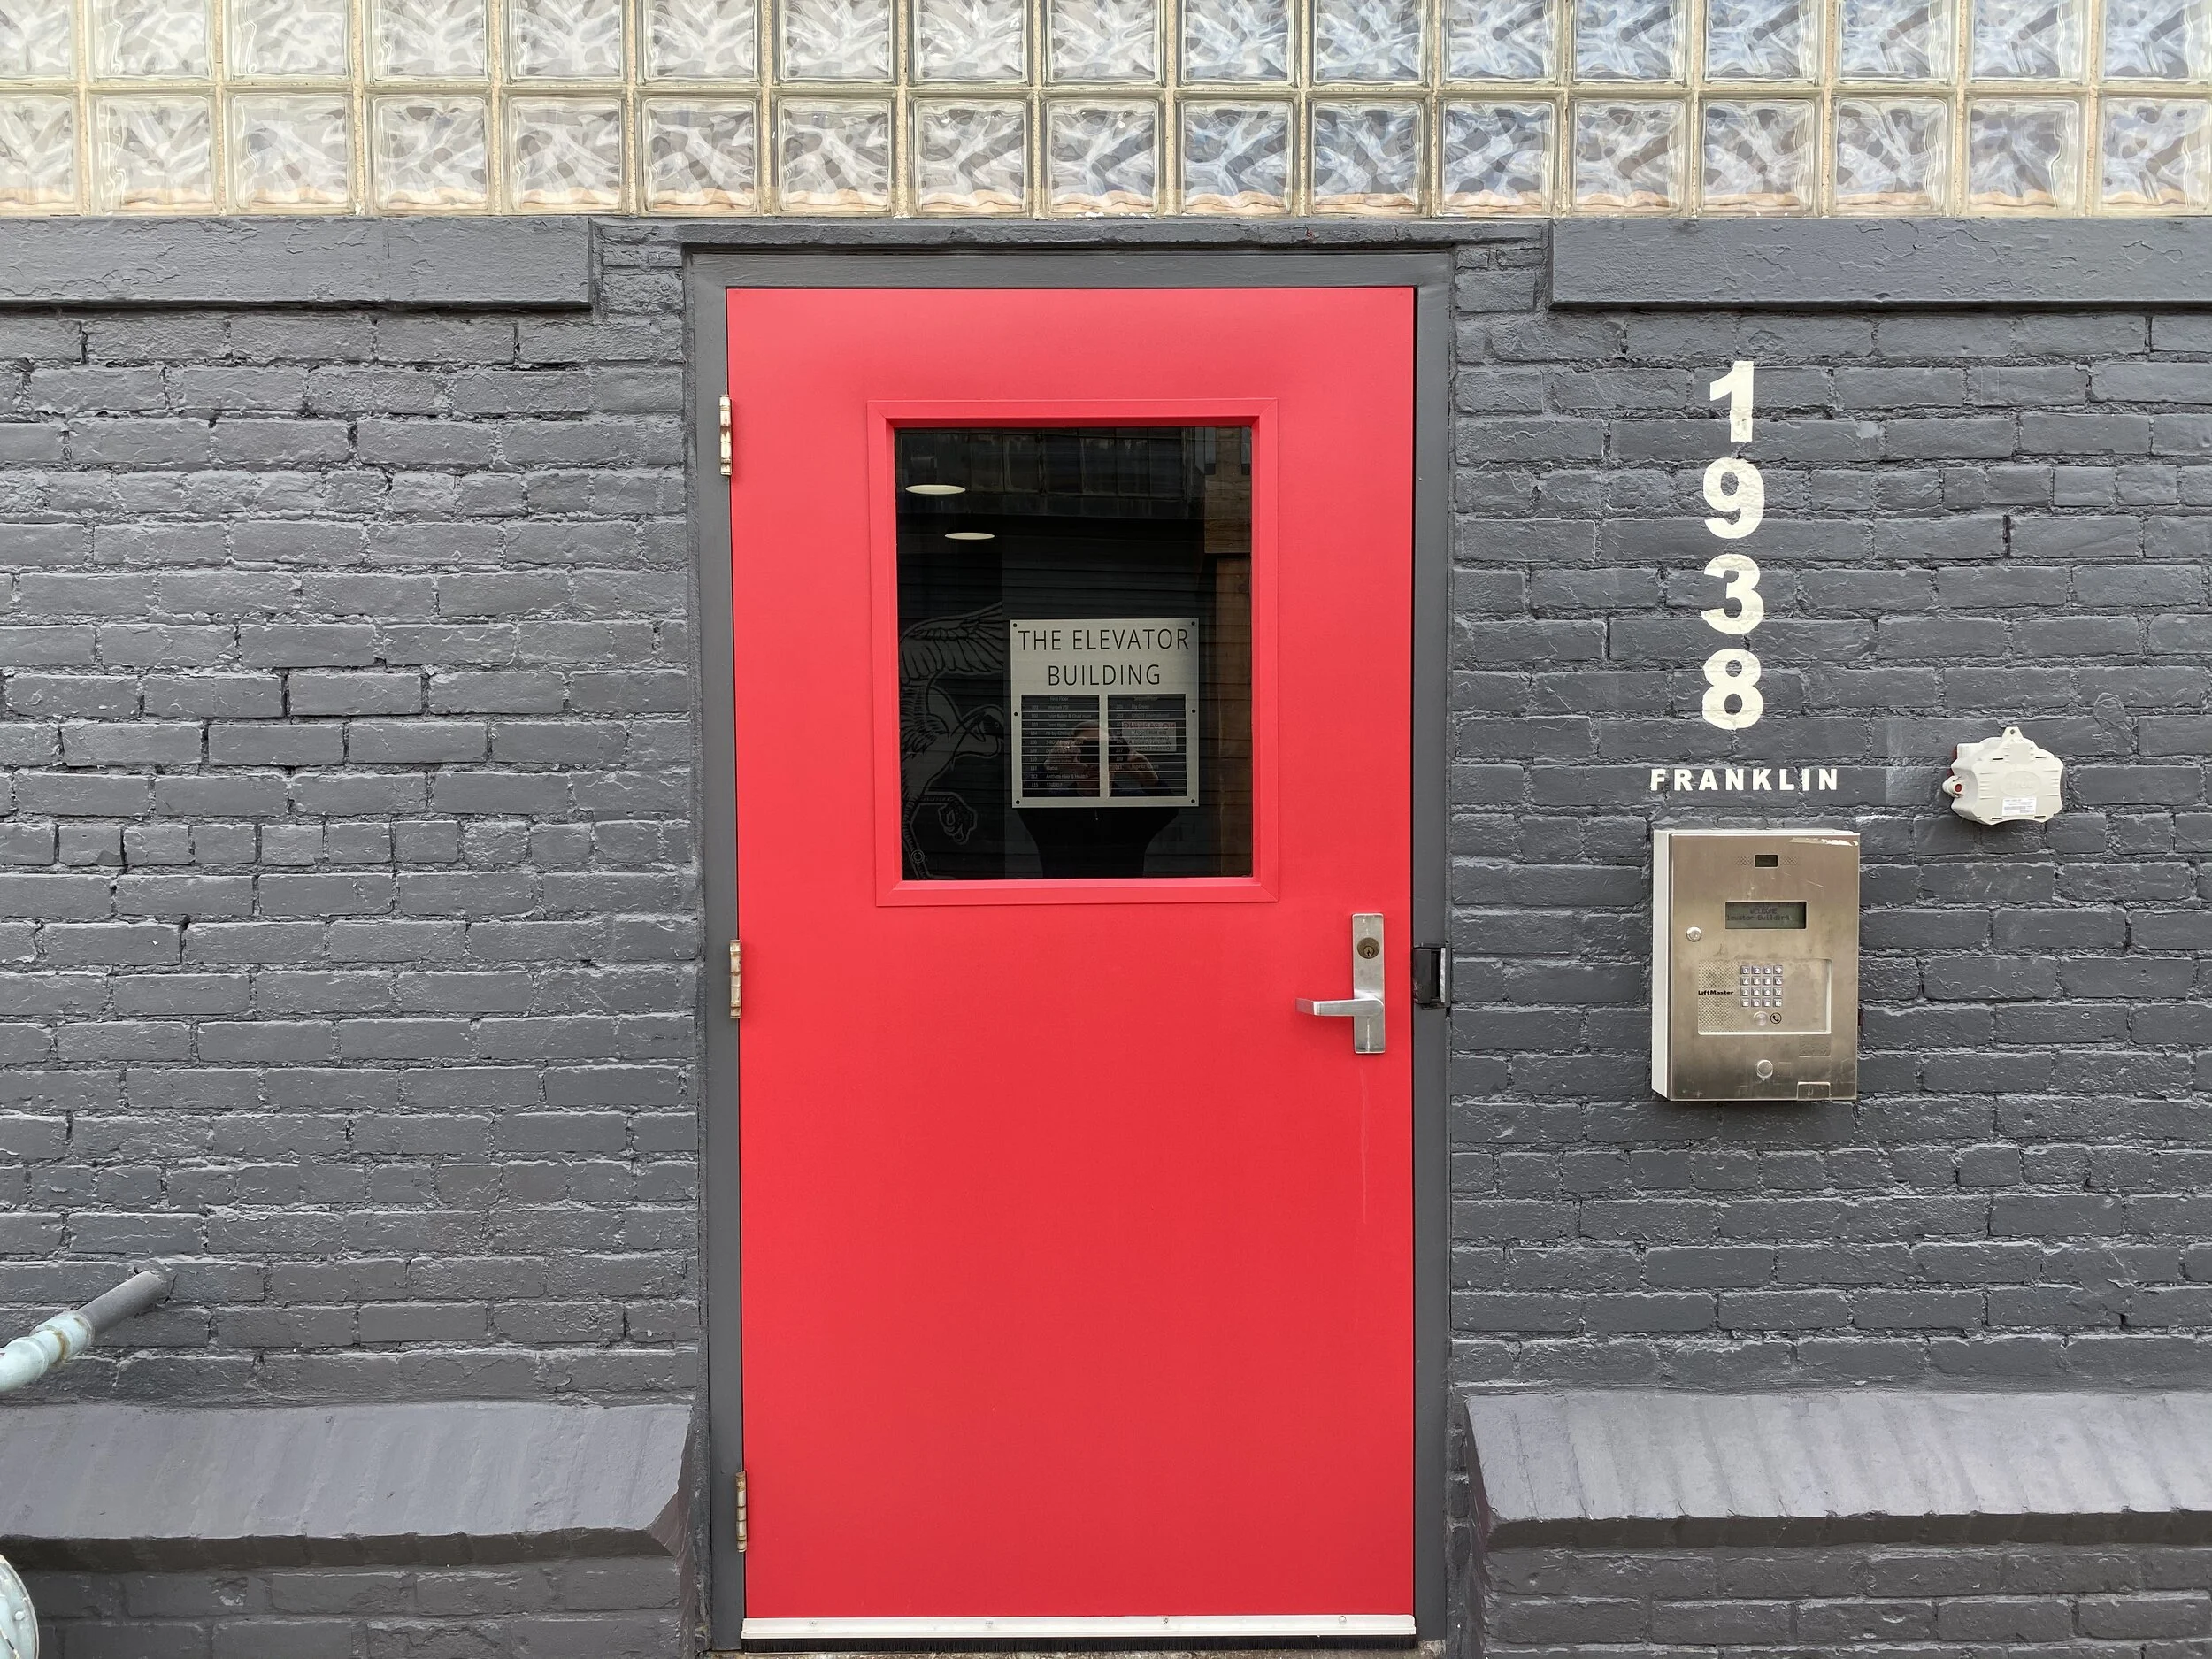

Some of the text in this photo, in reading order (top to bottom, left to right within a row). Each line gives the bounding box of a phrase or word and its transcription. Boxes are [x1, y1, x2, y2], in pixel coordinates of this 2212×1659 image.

[1701, 361, 1765, 730] 1938
[1018, 629, 1189, 650] THE ELEVATOR
[1048, 664, 1160, 686] BUILDING
[1649, 768, 1839, 791] FRANKLIN
